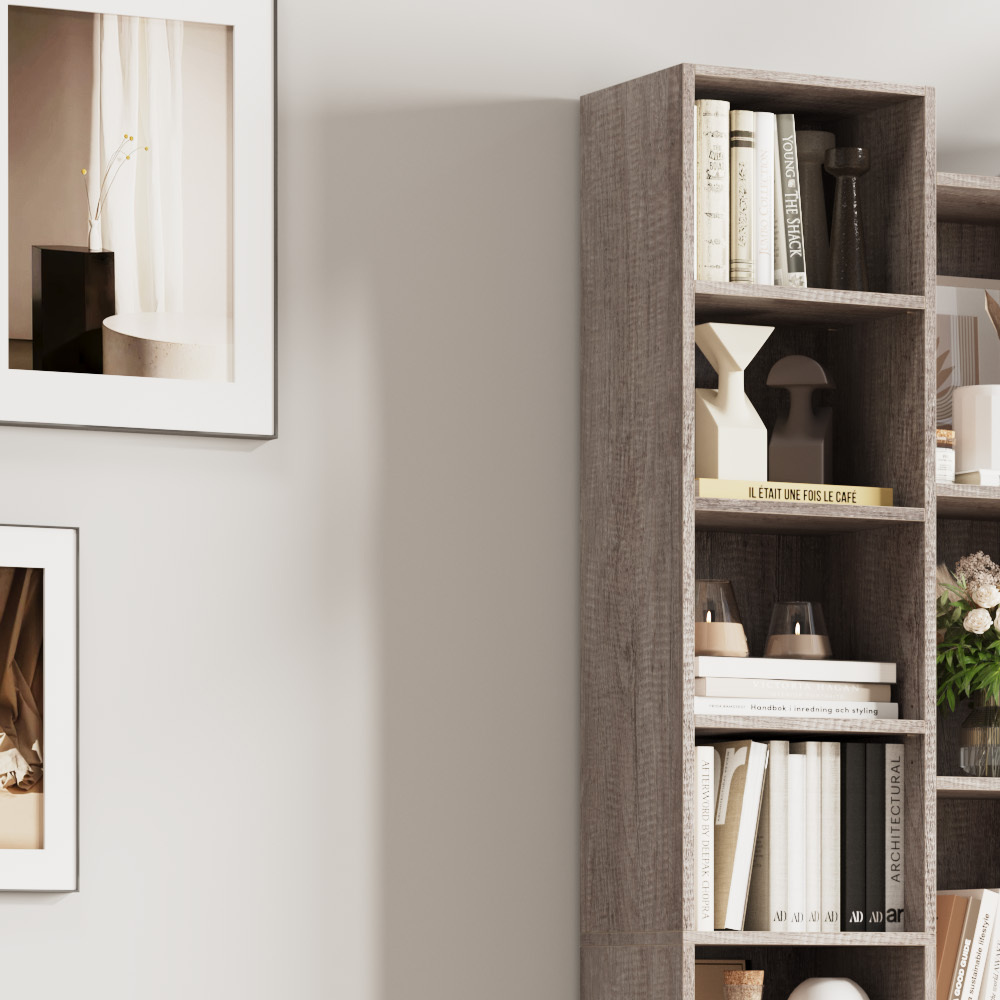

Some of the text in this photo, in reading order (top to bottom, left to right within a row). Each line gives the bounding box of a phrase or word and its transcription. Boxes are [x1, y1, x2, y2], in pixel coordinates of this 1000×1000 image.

[782, 135, 796, 183] YOUNG
[785, 191, 802, 258] THE SHACK
[748, 485, 857, 503] IL ÉTAIT UNE FOIS LE CAFÉ
[750, 704, 786, 712] Handbok
[794, 706, 832, 714] inredning
[852, 707, 879, 716] styling
[890, 755, 901, 883] ARCHITECTURAL
[701, 760, 710, 920] AFTERWORD BY DEEPAK CHOPRA
[773, 911, 787, 922] AD
[791, 912, 804, 923] AD
[809, 911, 820, 922] AD
[825, 911, 838, 923] AD
[849, 911, 864, 923] AD
[869, 911, 883, 923] AD
[887, 908, 904, 923] ar
[969, 947, 983, 995] sustainable
[979, 913, 990, 944] lifestyle
[954, 968, 966, 996] GOOD
[961, 939, 972, 967] GUIDE
[992, 973, 1000, 994] world
